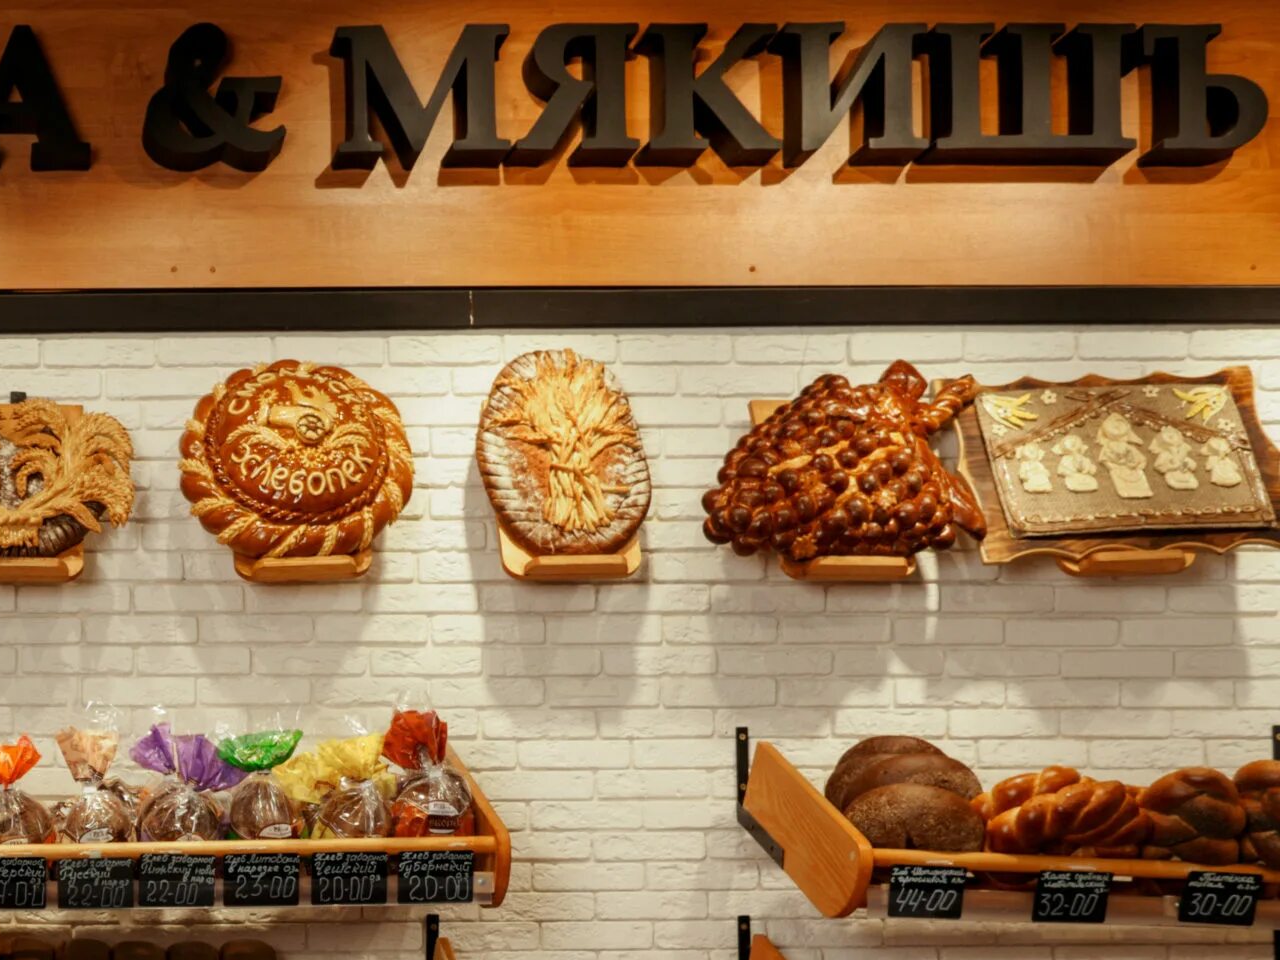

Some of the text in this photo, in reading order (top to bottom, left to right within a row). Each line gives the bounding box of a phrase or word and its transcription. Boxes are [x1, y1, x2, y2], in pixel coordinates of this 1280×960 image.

[144, 22, 286, 174] &
[330, 20, 1270, 176] МЯКИШЪ
[68, 883, 125, 907] 22-00
[147, 880, 199, 904] 22-00
[235, 872, 296, 899] 23-00
[320, 876, 375, 901] 20-00
[409, 875, 469, 901] 20-00
[896, 888, 958, 913] 44-00
[1037, 892, 1099, 917] 32-00
[1188, 892, 1254, 917] 30-00
